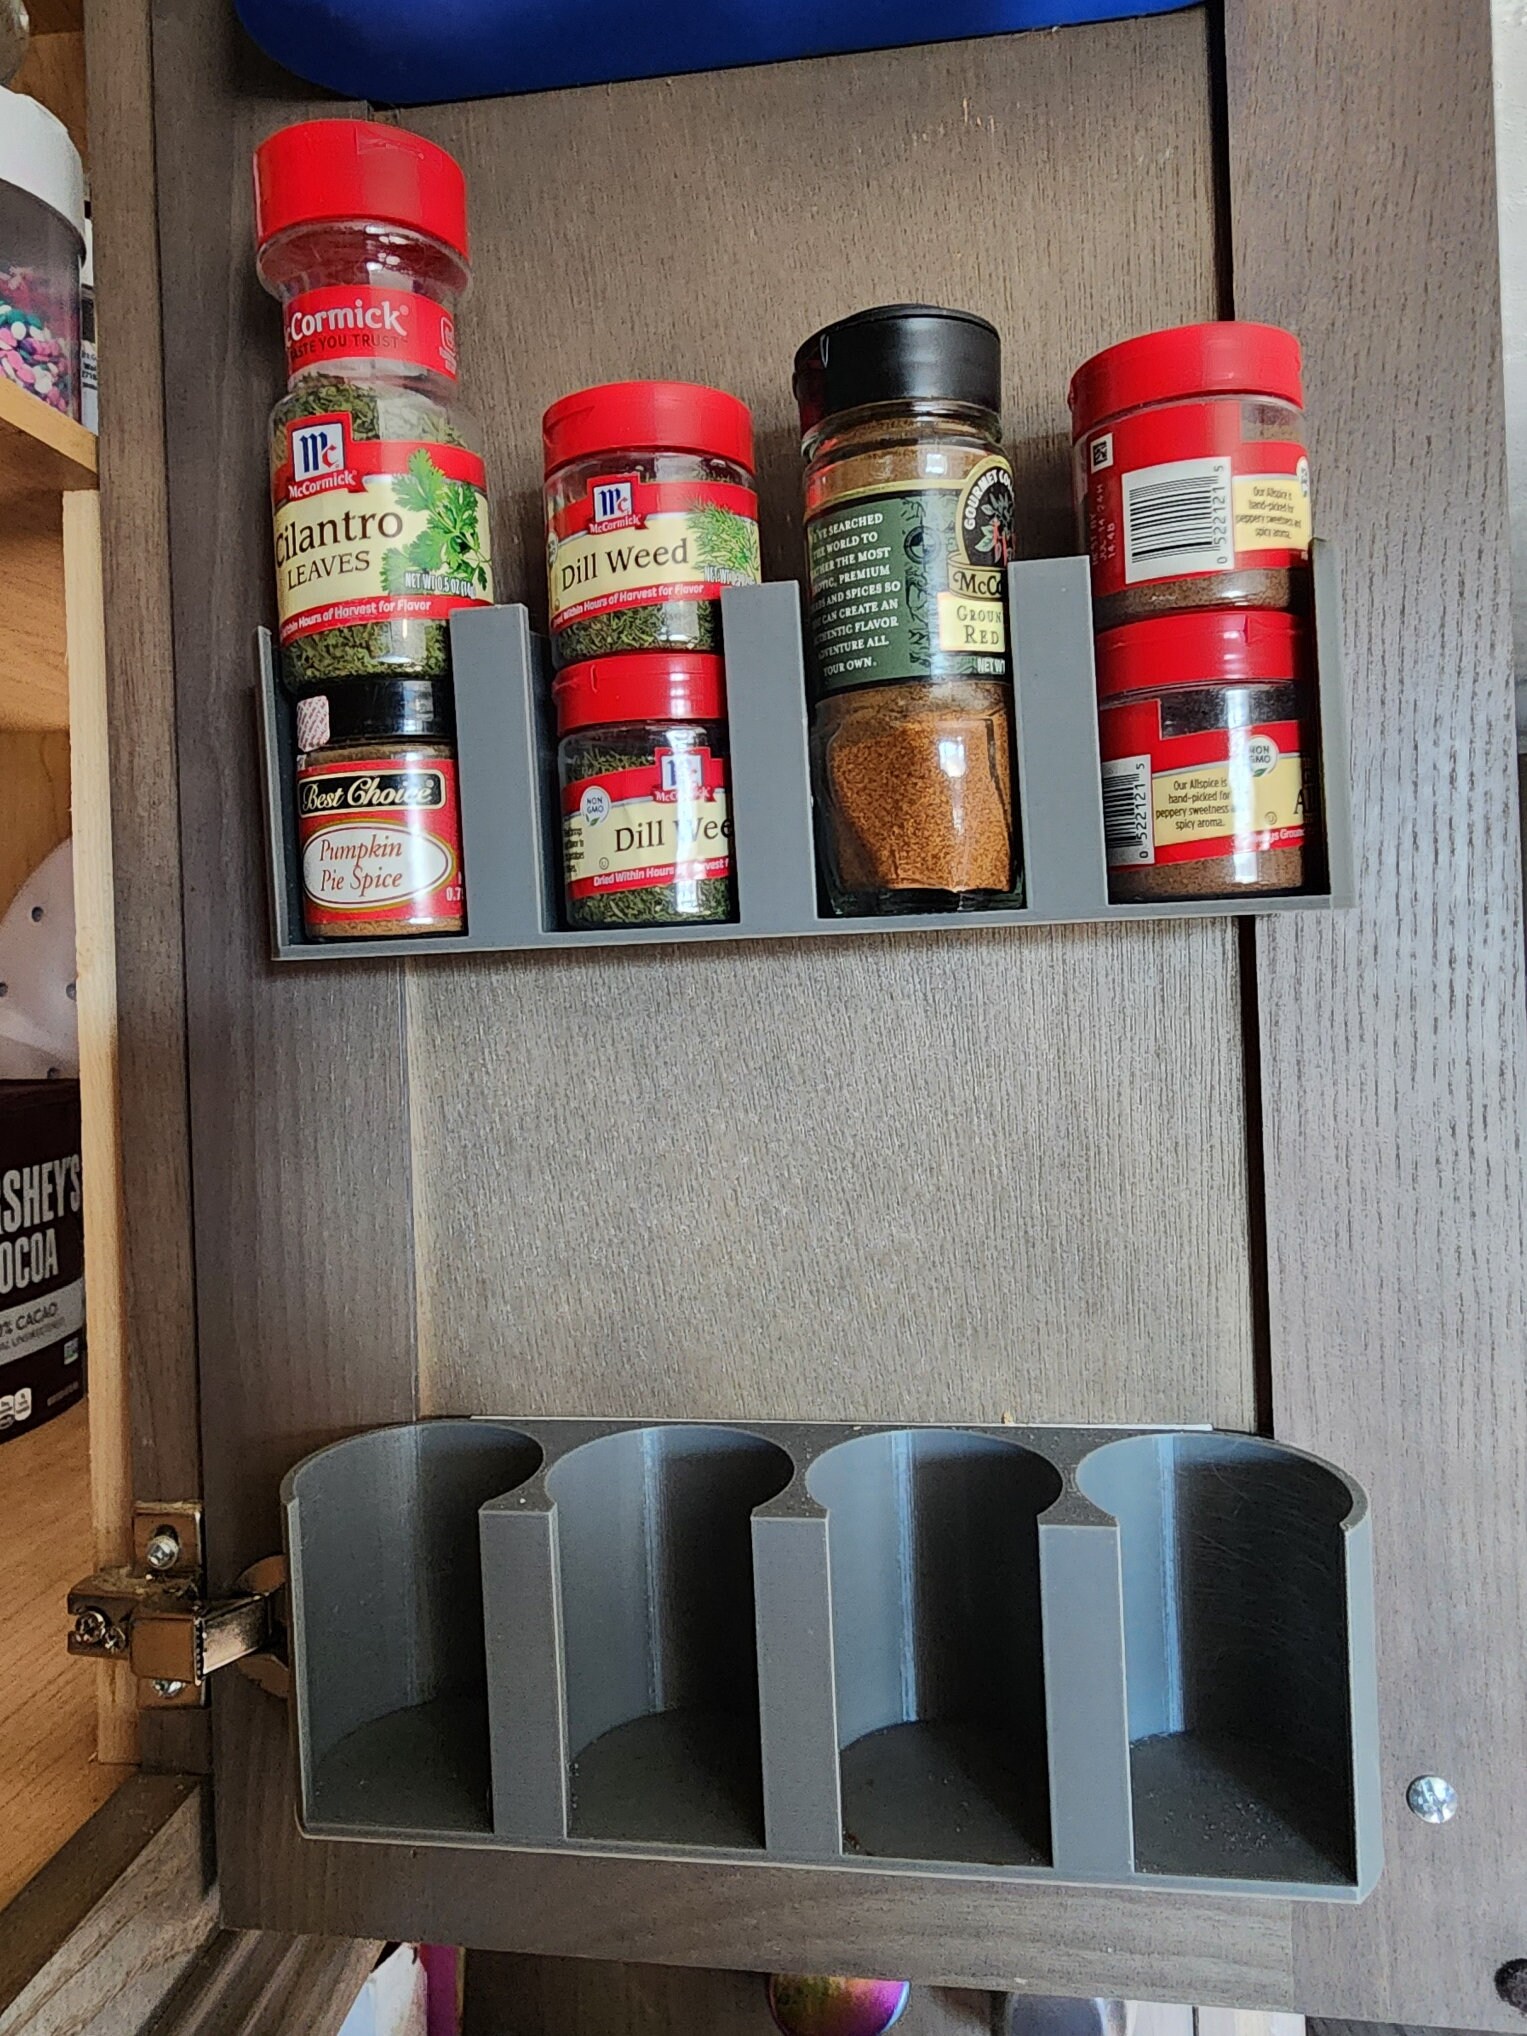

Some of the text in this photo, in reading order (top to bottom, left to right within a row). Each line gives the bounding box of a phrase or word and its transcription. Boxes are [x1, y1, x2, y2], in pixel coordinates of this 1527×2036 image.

[318, 335, 347, 351] YOU
[352, 332, 399, 349] TRUST
[288, 470, 356, 499] McCormick
[963, 469, 999, 530] GOURMET
[588, 513, 642, 534] McCormick
[828, 513, 883, 536] SEARCHED
[1213, 486, 1228, 545] 522121
[274, 510, 403, 569] Cilantro
[826, 535, 860, 553] WORLD
[861, 531, 878, 544] TO
[561, 553, 598, 592] Dill
[605, 537, 688, 575] Weed
[835, 553, 856, 568] THE
[857, 547, 892, 562] MOST
[288, 550, 370, 591] LEAVES
[405, 571, 420, 589] NET
[839, 564, 891, 584] PREMIUM
[584, 598, 608, 612] Hours
[608, 594, 619, 605] of
[619, 588, 657, 603] Harvest
[658, 585, 672, 597] for
[674, 583, 704, 595] Flavor
[826, 581, 901, 605] AND SPICES SO
[299, 613, 322, 629] Hours
[323, 608, 334, 621] of
[334, 603, 378, 619] Harvest
[379, 600, 394, 613] for
[397, 599, 431, 612] Flavor
[822, 610, 837, 624] CAN
[839, 601, 879, 619] CREATE
[880, 598, 898, 611] AN
[956, 605, 1002, 623] GROUN
[854, 616, 899, 633] FLAVOR
[964, 624, 1000, 645] RED
[866, 634, 890, 648] ALL
[824, 656, 877, 677] YOUR OWN.
[302, 777, 431, 811] Best Choice
[1173, 778, 1228, 791] Our Allspice is
[587, 797, 604, 806] NON
[1168, 790, 1231, 805] hand-picked for
[586, 804, 605, 814] GMO
[1134, 783, 1149, 841] 522121
[1156, 807, 1186, 819] peppery
[1188, 805, 1230, 816] sweetness
[1175, 817, 1226, 831] spicy aroma.
[614, 820, 665, 853] Dill
[319, 834, 402, 868] Pumpkin
[320, 865, 403, 898] Pie Spice
[594, 874, 614, 887] Dried
[615, 870, 644, 882] Within
[646, 866, 675, 878] Hours
[446, 886, 464, 901] 0.7
[15, 1302, 58, 1331] CACAO
